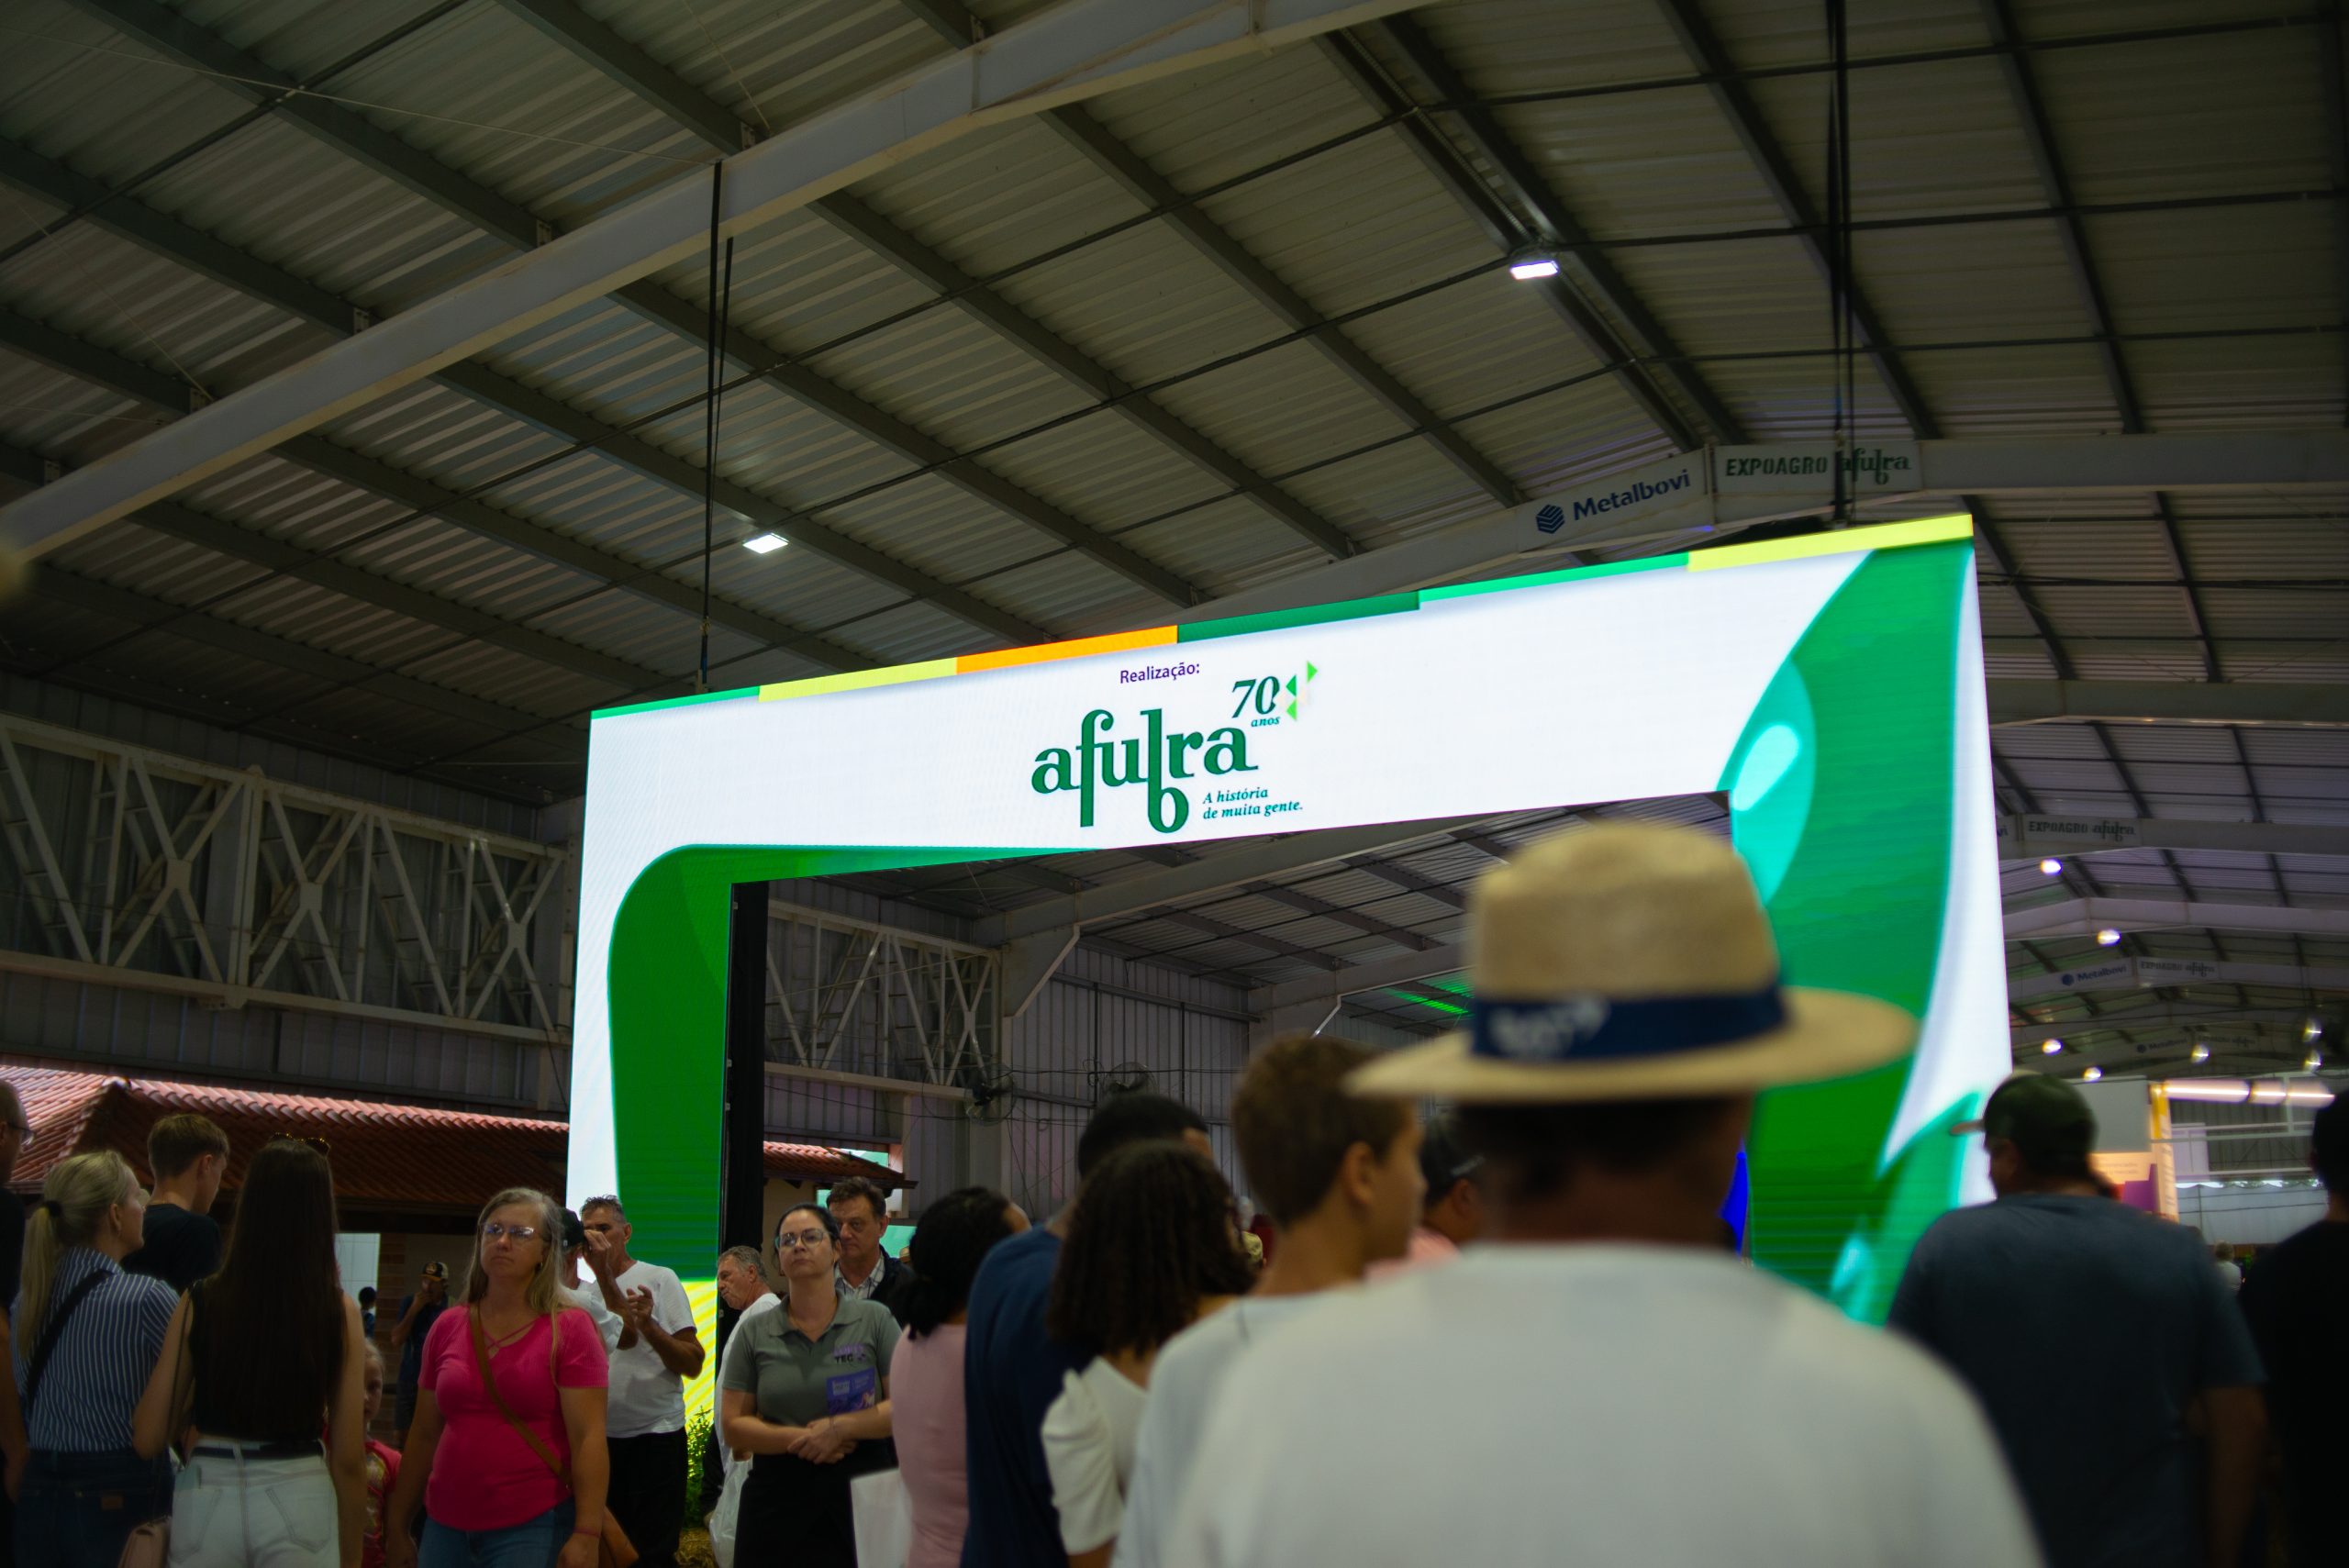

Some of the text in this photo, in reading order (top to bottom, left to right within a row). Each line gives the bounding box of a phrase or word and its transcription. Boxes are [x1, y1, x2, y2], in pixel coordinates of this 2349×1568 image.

[1725, 456, 1828, 476] EXPOAGRO
[1573, 469, 1691, 521] Metalbovi
[1119, 662, 1200, 684] Realização:
[1231, 676, 1280, 718] 70
[1251, 716, 1281, 728] anos
[1031, 708, 1259, 834] afubra
[1203, 787, 1269, 804] A história
[1203, 800, 1303, 819] de muita gente.
[2028, 821, 2088, 833] EXPOAGRO
[2076, 964, 2127, 981] Metalbovi
